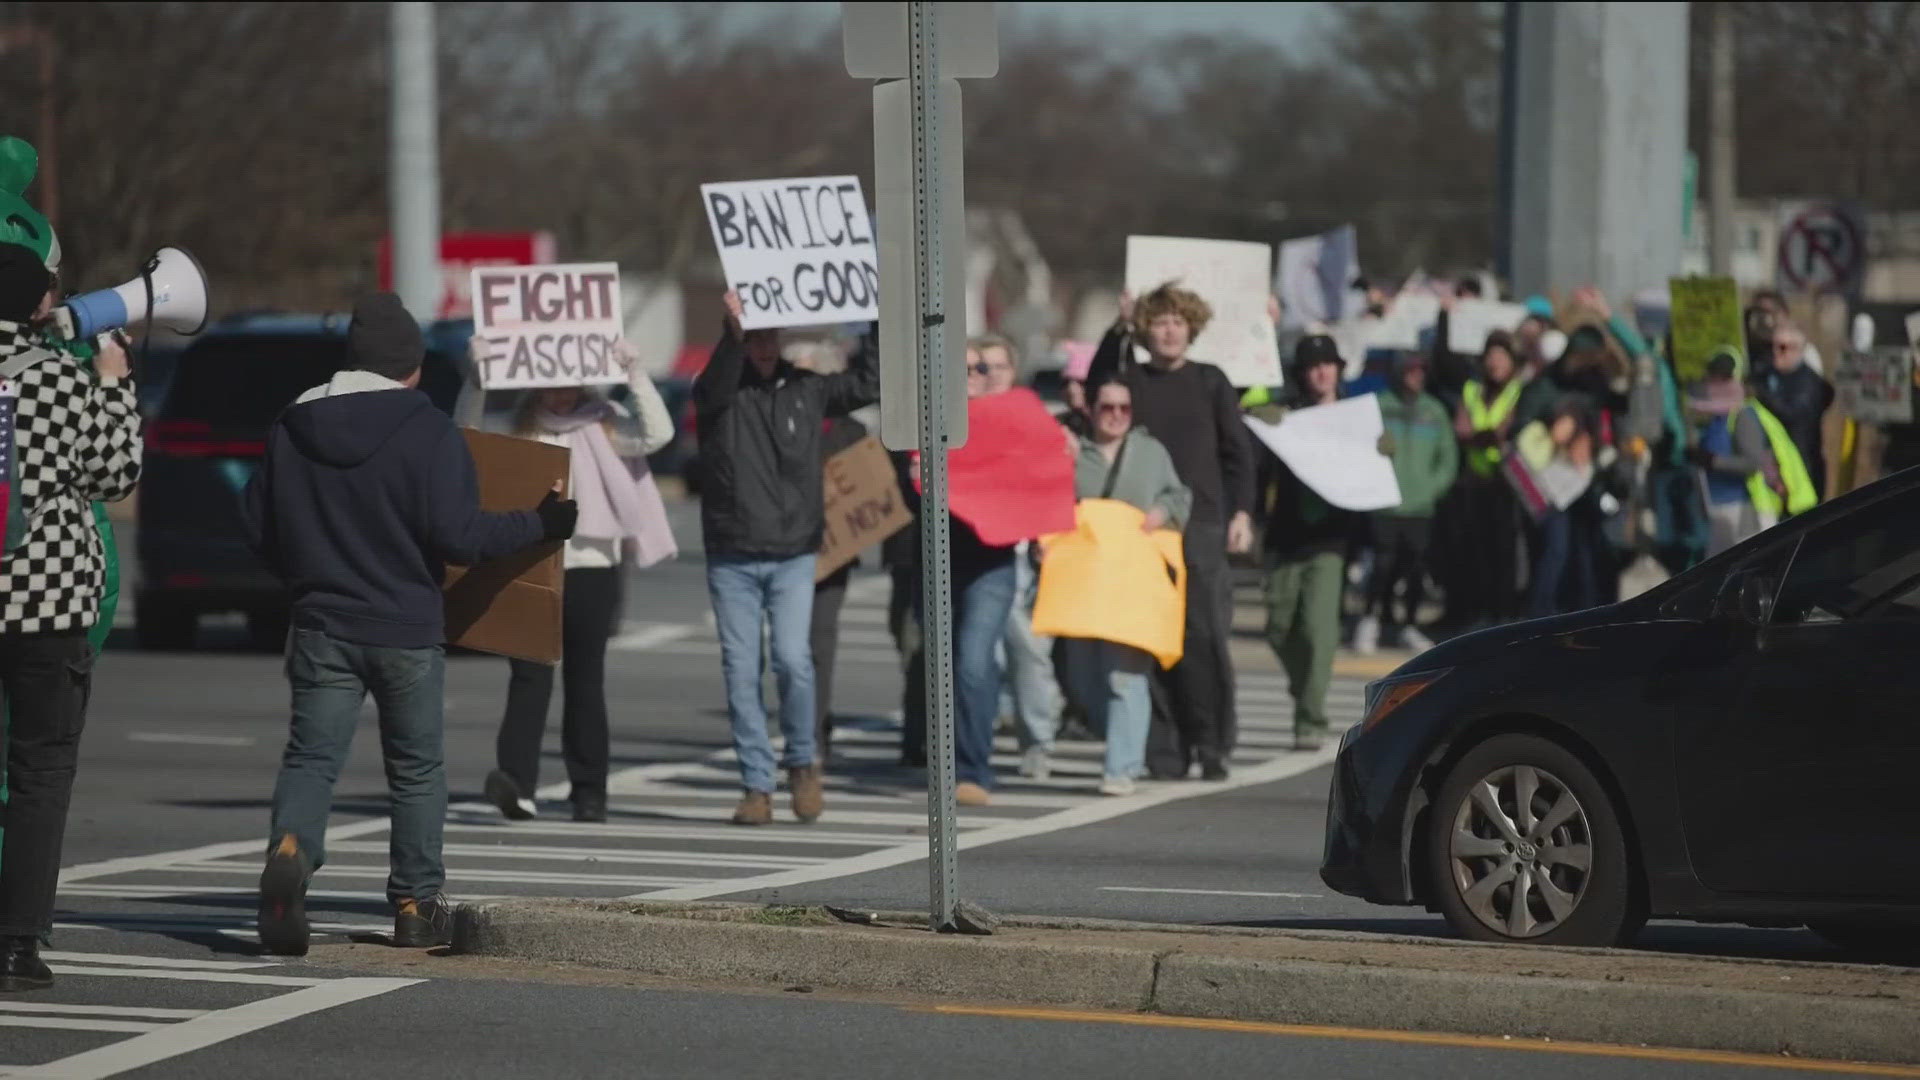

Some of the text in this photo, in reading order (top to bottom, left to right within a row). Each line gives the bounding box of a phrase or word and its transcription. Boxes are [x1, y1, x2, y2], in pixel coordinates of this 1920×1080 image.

[709, 184, 869, 250] BAN ICE
[480, 272, 616, 327] FIGHT
[736, 276, 793, 318] FOR
[482, 332, 619, 382] FASCISM
